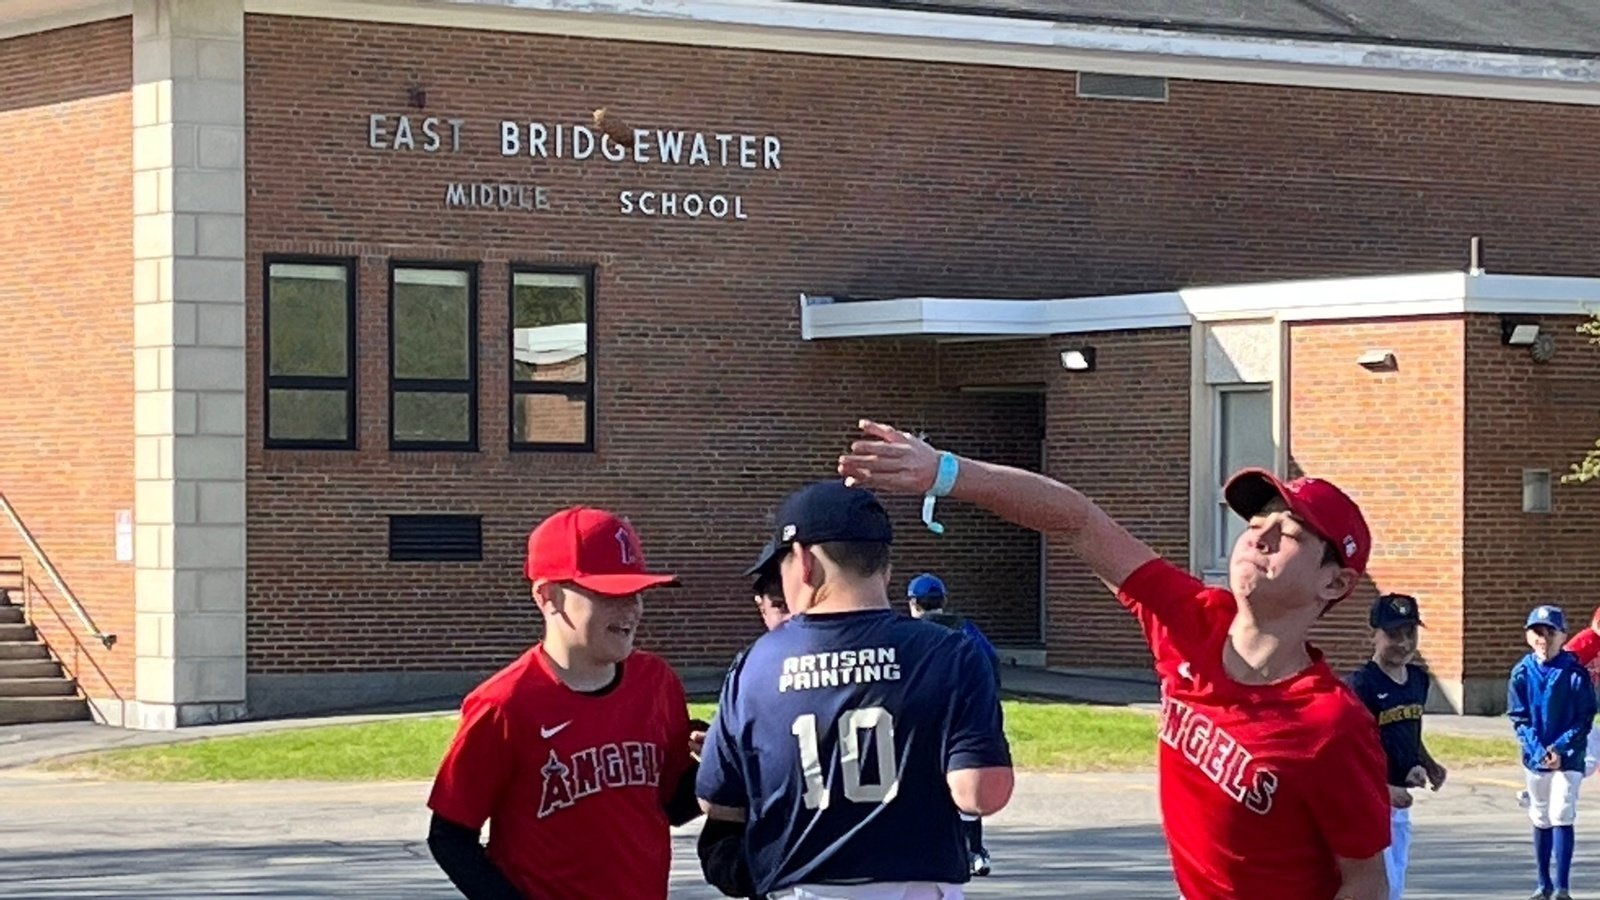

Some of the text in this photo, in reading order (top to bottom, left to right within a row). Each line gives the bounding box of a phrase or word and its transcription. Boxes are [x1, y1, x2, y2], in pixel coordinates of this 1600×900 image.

[369, 114, 464, 151] EAST
[446, 183, 748, 219] MIDDLE SCHOOL
[779, 664, 901, 692] PAINTING
[783, 648, 896, 674] ARTISAN
[792, 706, 899, 810] 10
[1159, 696, 1278, 814] NGELS
[537, 741, 664, 818] ANGEL
